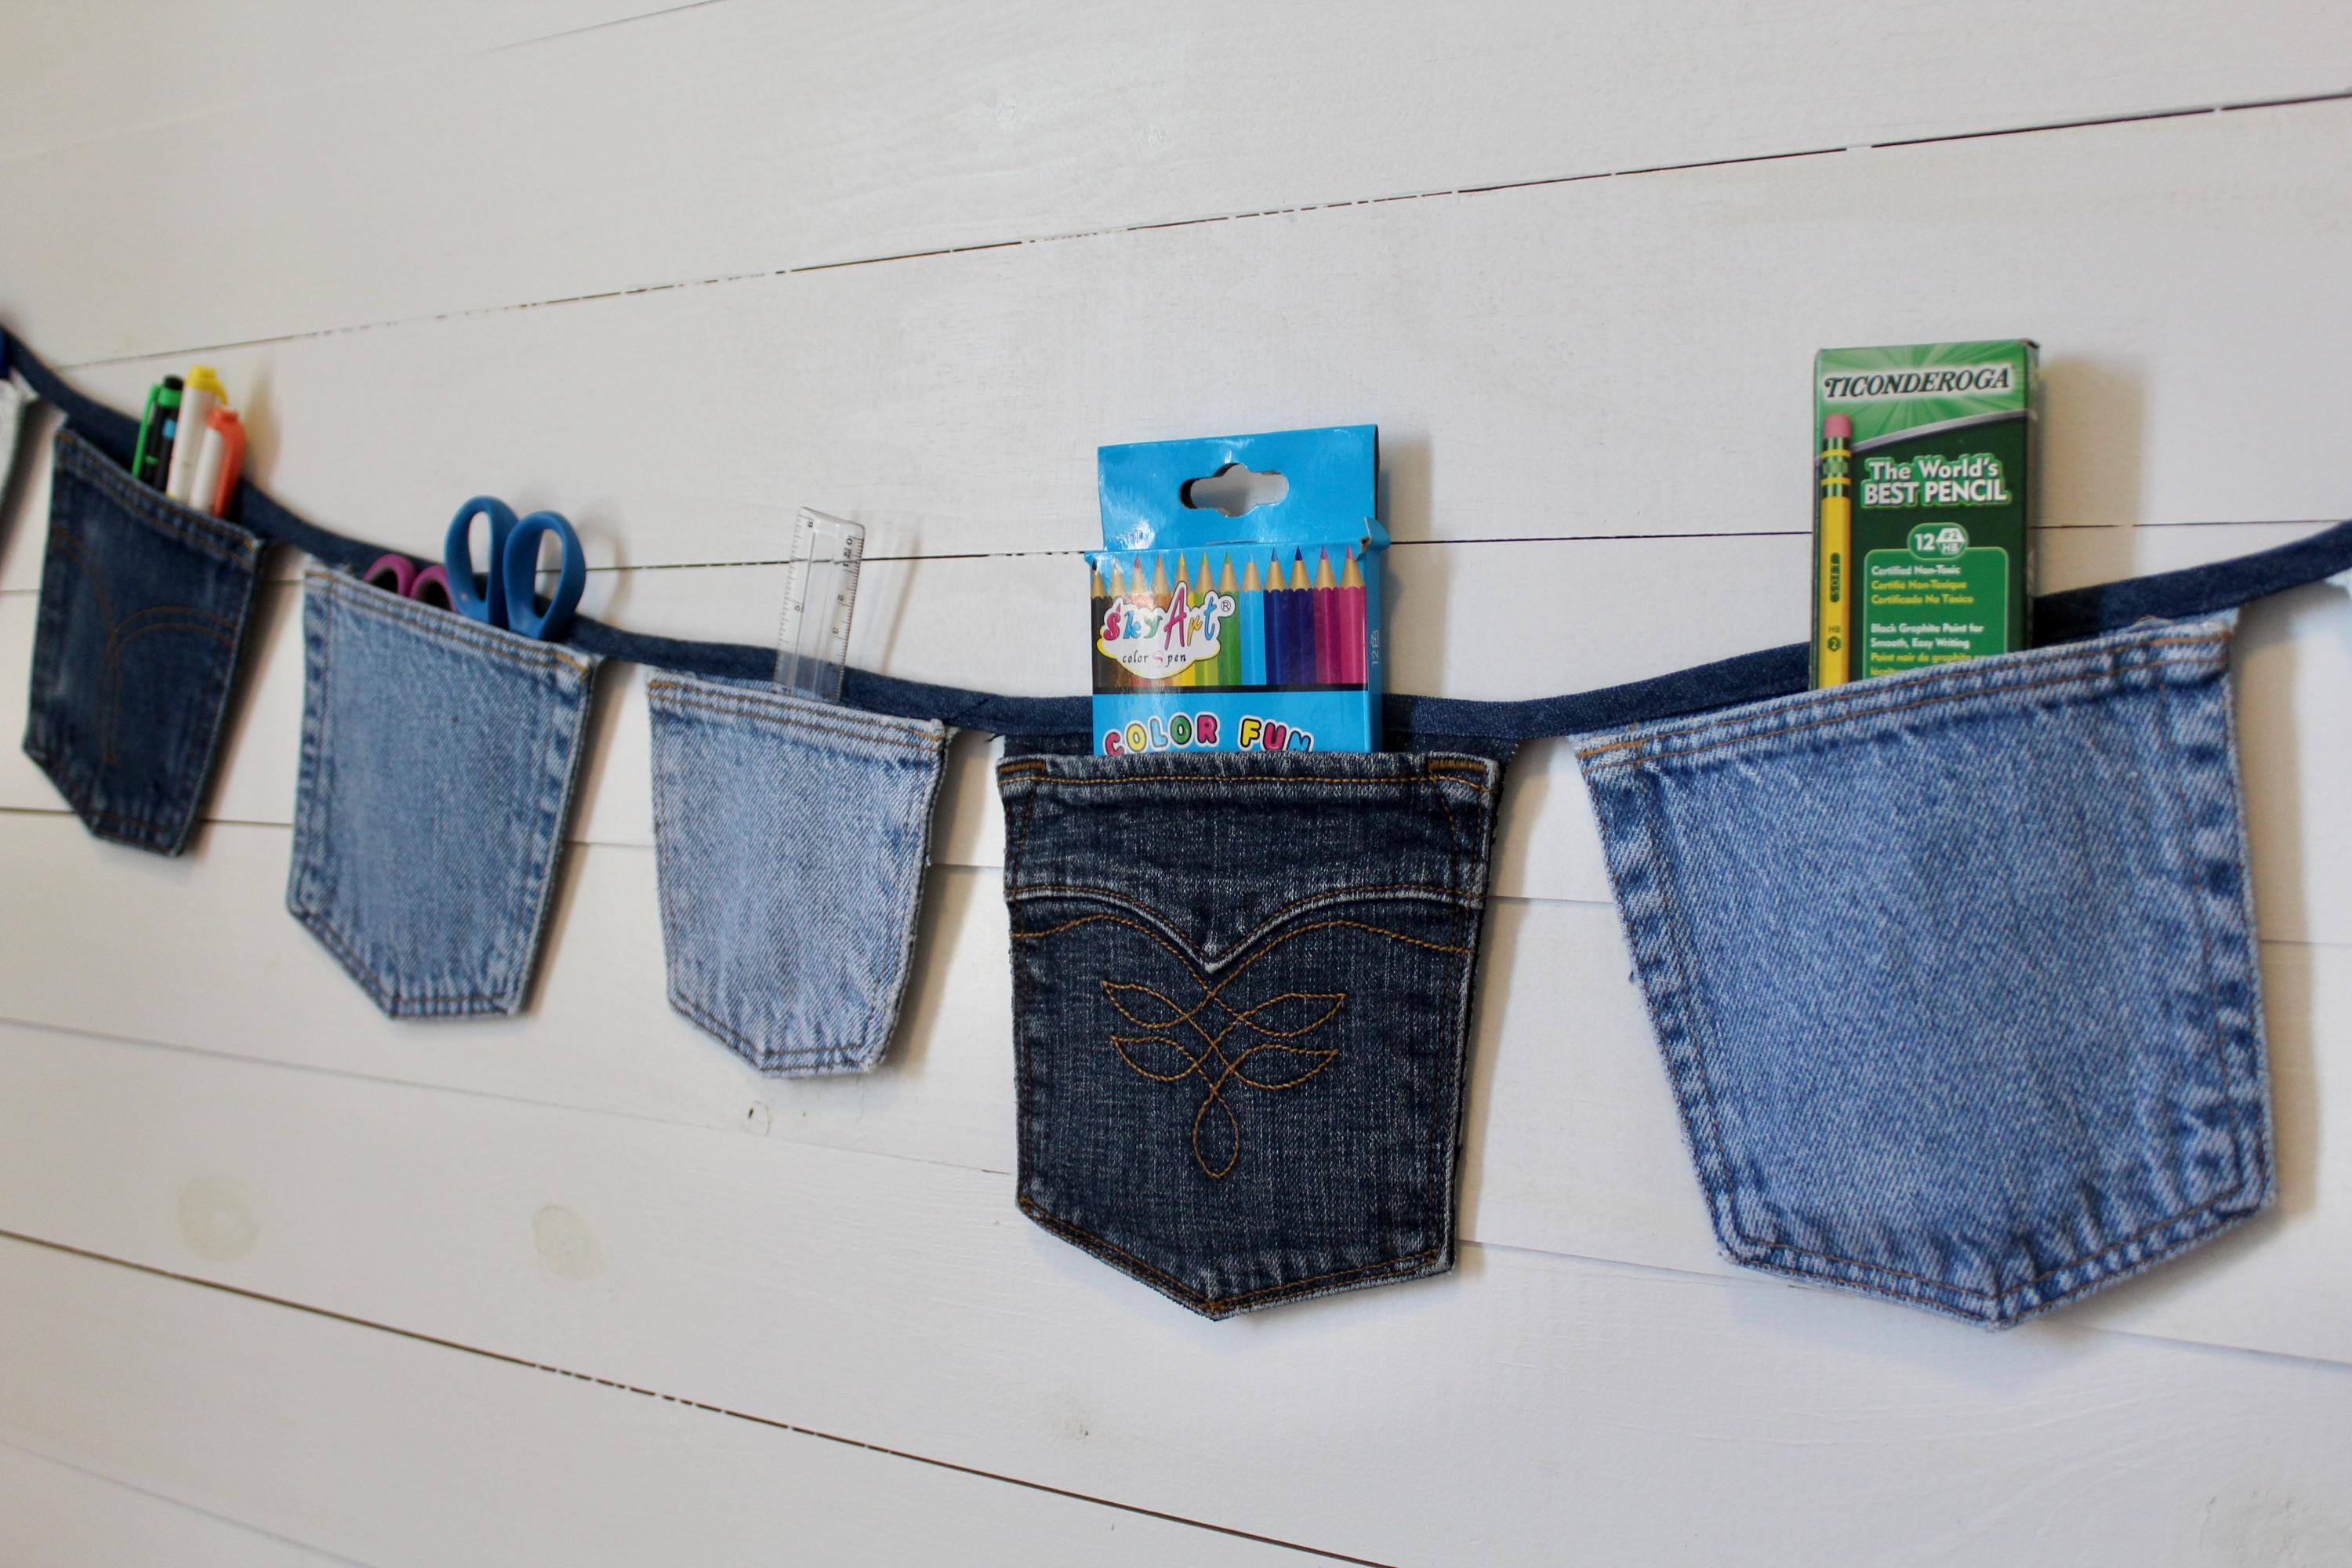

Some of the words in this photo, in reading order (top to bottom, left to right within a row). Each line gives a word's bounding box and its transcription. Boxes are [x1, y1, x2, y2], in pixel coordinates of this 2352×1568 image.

[1824, 368, 2010, 397] TICONDEROGA
[1868, 461, 1911, 481] The
[1918, 457, 1999, 479] World's
[1864, 481, 1920, 506] BEST
[1924, 477, 2008, 503] PENCIL
[1915, 533, 1936, 550] 12
[1122, 651, 1149, 663] color
[1167, 653, 1187, 667] pen
[1105, 713, 1218, 755] COLOR
[1240, 717, 1312, 753] FUN
